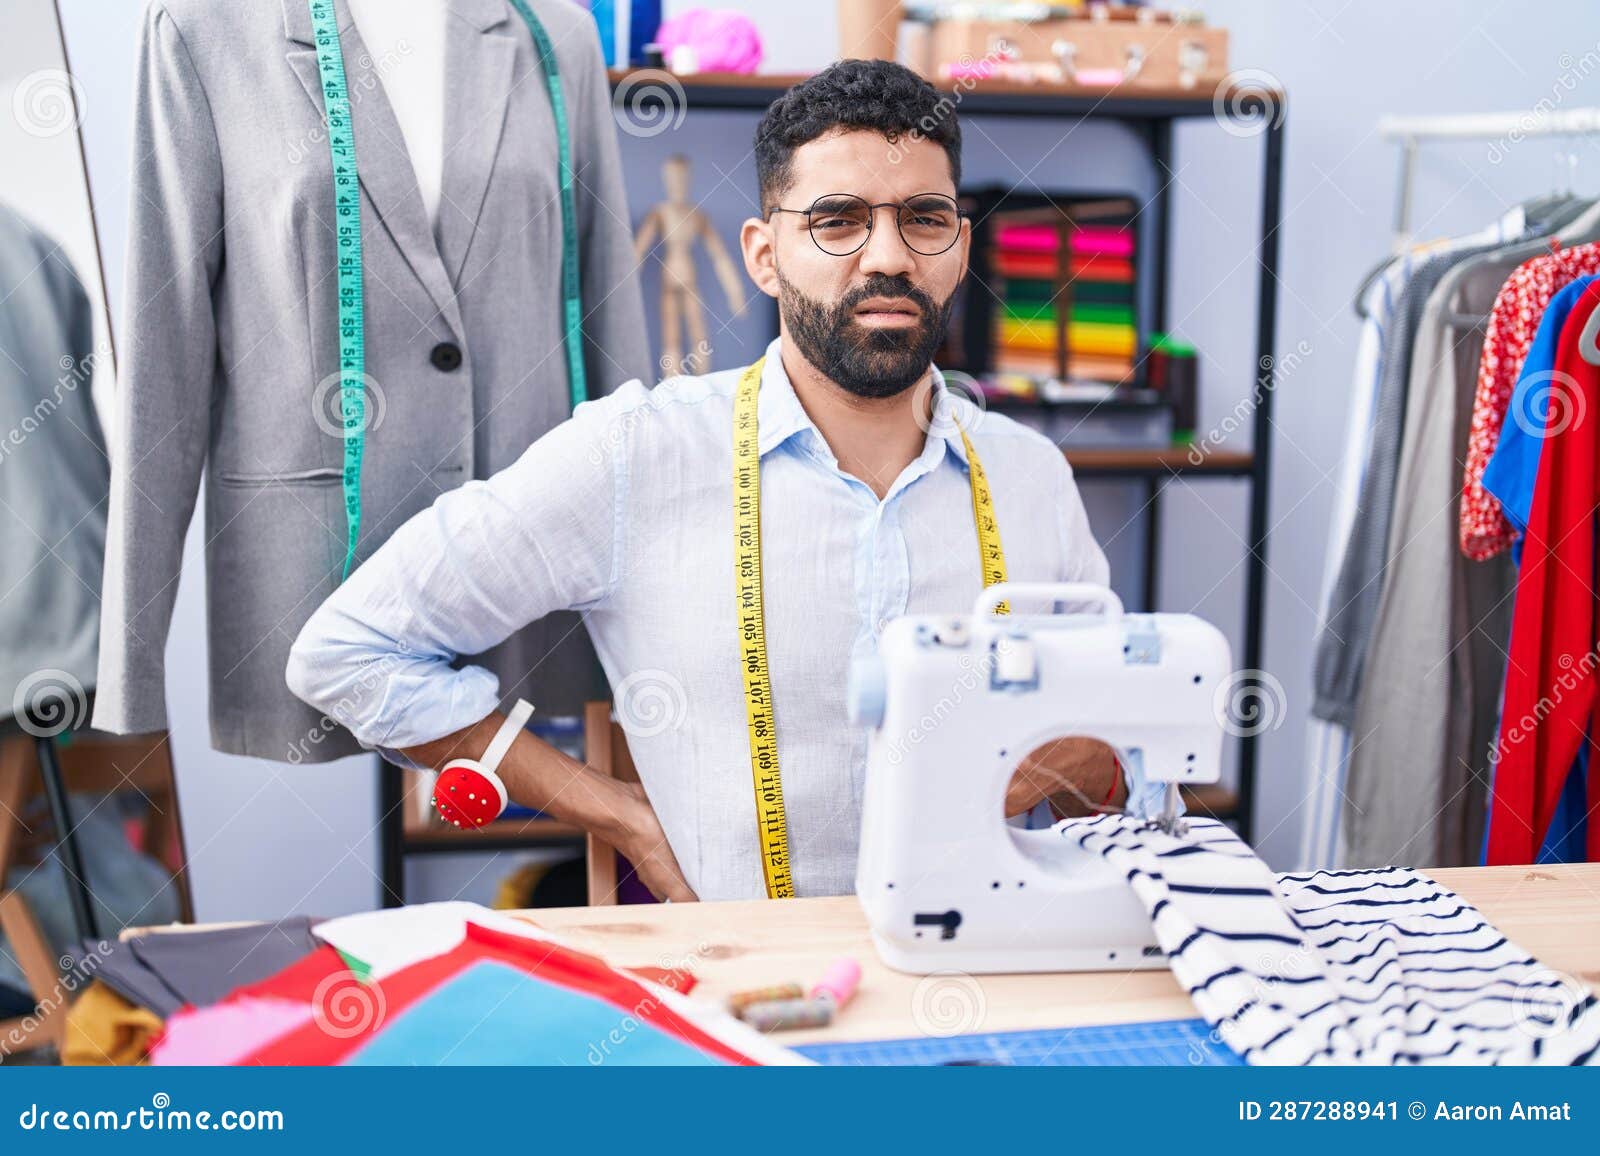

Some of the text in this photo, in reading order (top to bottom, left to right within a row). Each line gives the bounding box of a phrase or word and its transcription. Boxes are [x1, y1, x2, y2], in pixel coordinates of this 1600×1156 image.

[312, 2, 326, 20] 42
[316, 28, 331, 47] 43
[321, 55, 336, 71] 44
[325, 80, 339, 99] 45
[329, 108, 344, 127] 46
[333, 136, 347, 156] 47
[336, 166, 350, 186] 48
[338, 196, 352, 216] 49
[340, 227, 352, 247] 50
[340, 257, 353, 277] 51
[341, 288, 354, 308] 52
[342, 317, 354, 339] 53
[343, 347, 355, 368] 54
[344, 378, 356, 398] 55
[740, 387, 752, 404] 97
[345, 407, 357, 428] 56
[739, 411, 750, 431] 98
[347, 437, 358, 458] 57
[739, 439, 750, 458] 99
[345, 466, 356, 487] 58
[739, 466, 751, 489] 100
[739, 495, 751, 518] 101
[981, 515, 994, 533] 82
[739, 523, 753, 548] 102
[988, 544, 1000, 561] 81
[740, 552, 754, 578] 103
[741, 585, 755, 609] 104
[743, 615, 757, 642] 105
[745, 647, 761, 674] 106
[749, 679, 764, 705] 107
[752, 711, 768, 738] 108
[756, 744, 772, 770] 109
[760, 775, 777, 802] 110
[765, 808, 780, 835] 111
[768, 840, 784, 867] 112
[773, 872, 788, 899] 113
